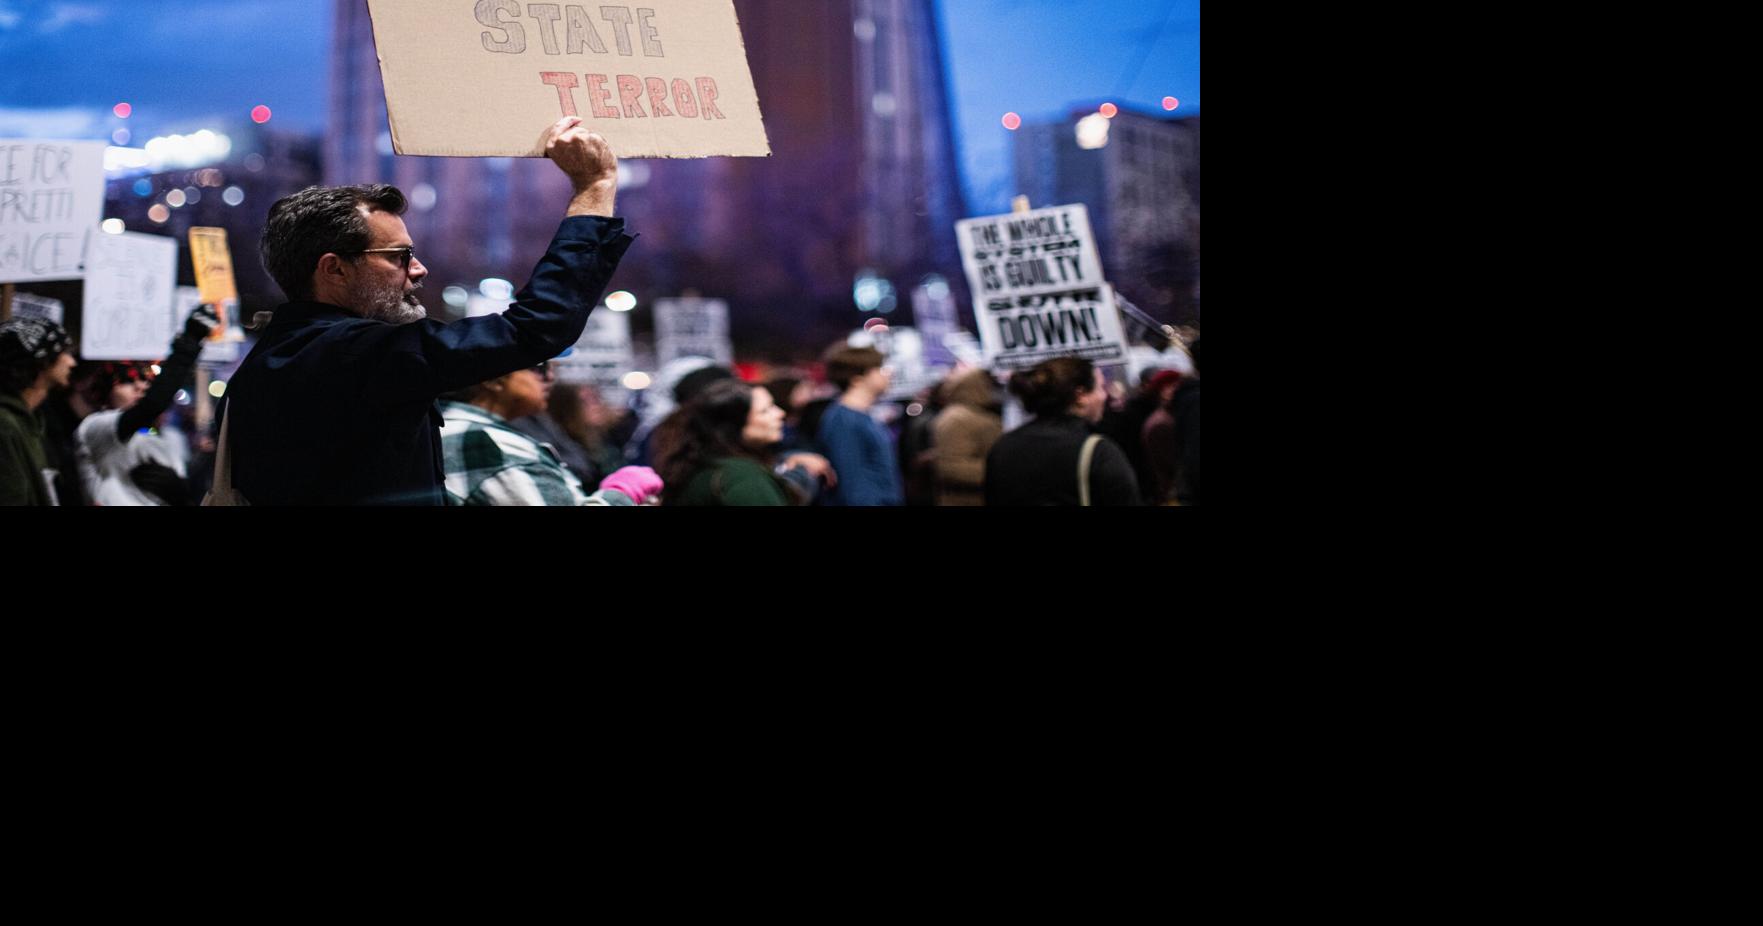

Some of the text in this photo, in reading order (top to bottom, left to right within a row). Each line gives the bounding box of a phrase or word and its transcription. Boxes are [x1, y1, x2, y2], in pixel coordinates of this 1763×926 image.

[473, 0, 665, 57] STATE
[539, 71, 726, 120] TERROR
[0, 144, 73, 186] E FOR
[970, 213, 1073, 246] THE WHOLE
[980, 255, 1084, 291] IS GUILTY
[998, 307, 1103, 349] DOWN!
